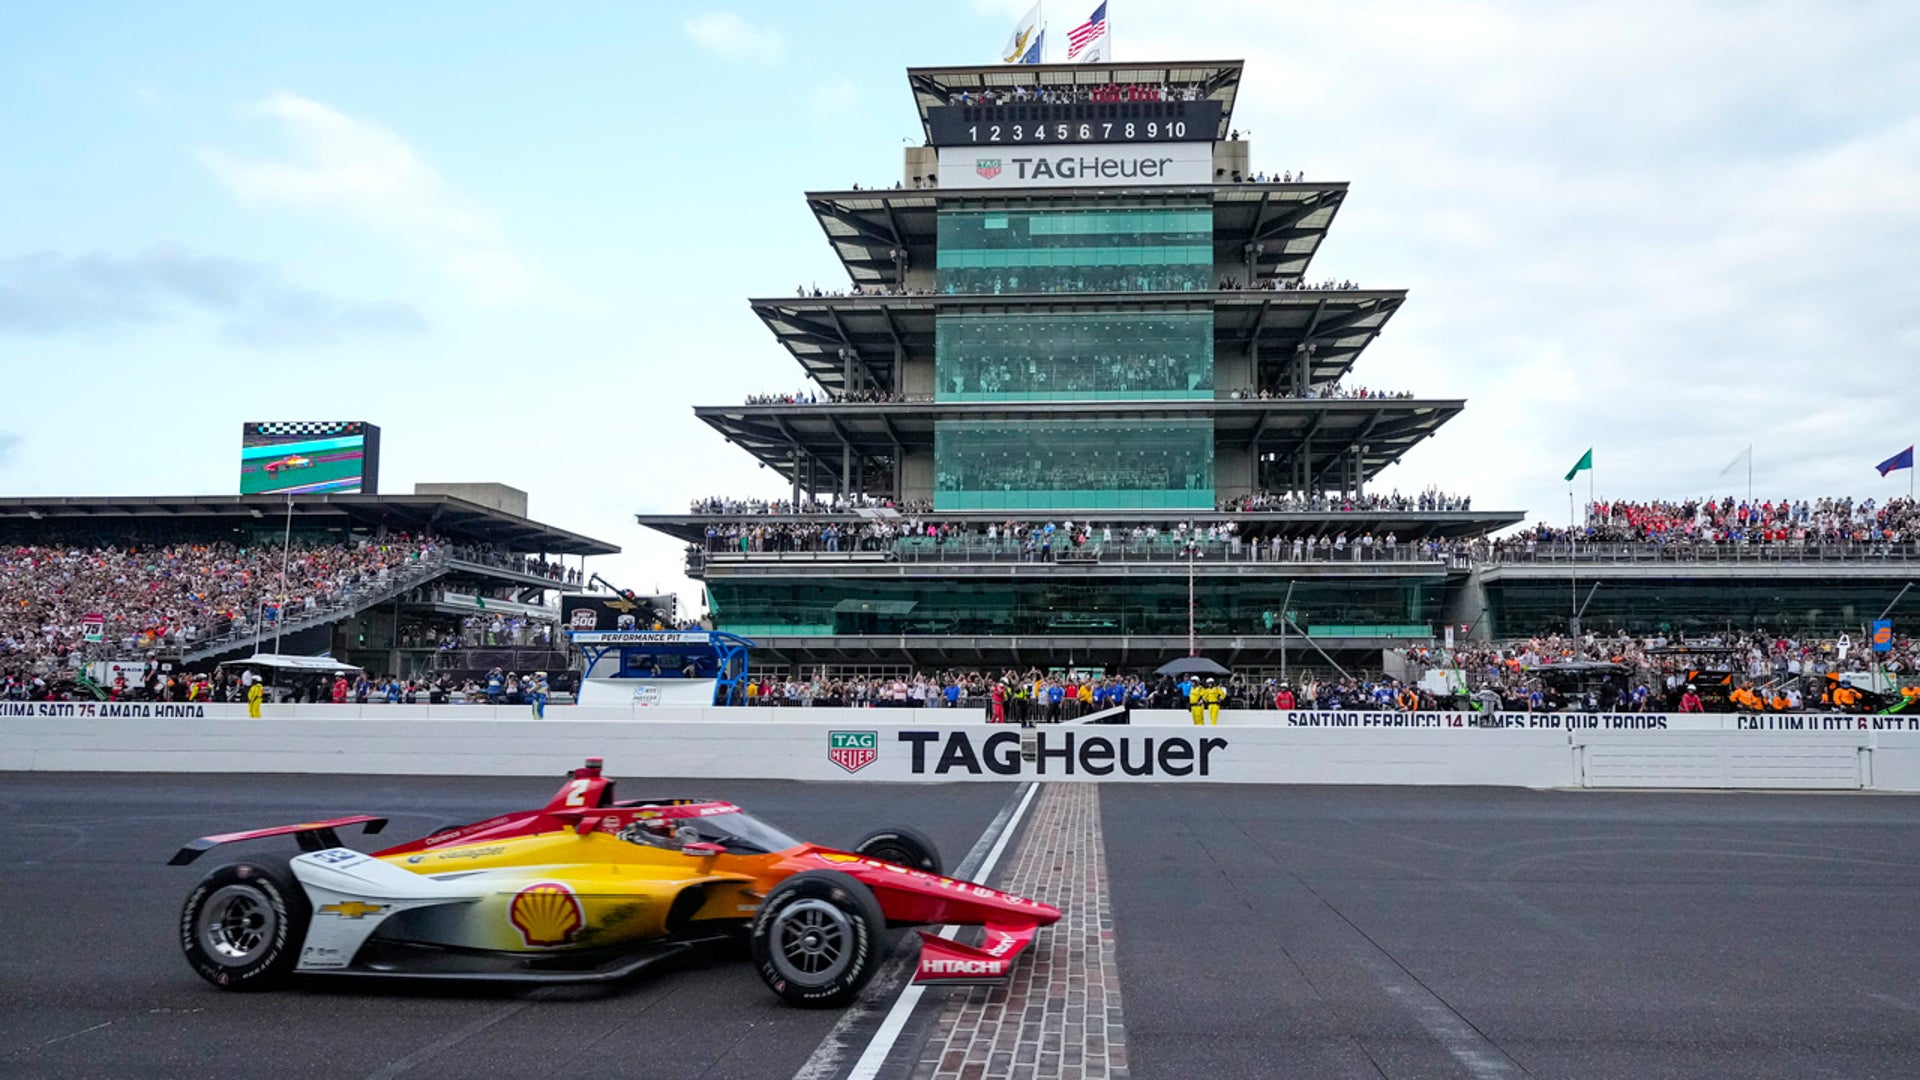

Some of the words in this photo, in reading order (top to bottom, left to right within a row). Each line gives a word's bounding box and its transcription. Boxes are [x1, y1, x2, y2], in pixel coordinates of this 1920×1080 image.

[970, 126, 977, 141] 1
[991, 126, 1000, 141] 2
[1013, 125, 1023, 140] 3
[1035, 125, 1045, 140] 4
[1057, 124, 1067, 139] 5
[1080, 124, 1090, 139] 6
[1103, 123, 1112, 138] 7
[1125, 123, 1135, 138] 8
[1147, 123, 1157, 138] 9
[1165, 122, 1186, 137] 10
[85, 623, 101, 634] 75
[572, 617, 596, 627] 500
[601, 633, 665, 641] PERFORMANCE
[667, 633, 681, 641] PIT
[39, 703, 74, 716] SATO
[79, 704, 95, 716] 75
[100, 704, 150, 717] AMADA
[155, 704, 204, 717] HONDA
[1288, 712, 1358, 727] SANTINO
[1363, 713, 1441, 727] FERRUCCI
[1446, 714, 1463, 727] 14
[1530, 714, 1560, 728] FOR
[1565, 715, 1598, 728] OUR
[1603, 715, 1668, 728] TROOPS
[1858, 717, 1867, 729] 6
[1872, 717, 1904, 729] NTT
[833, 735, 872, 746] TAG
[832, 750, 874, 769] HEUER
[565, 779, 590, 806] 2
[922, 959, 1002, 973] HITACHI
